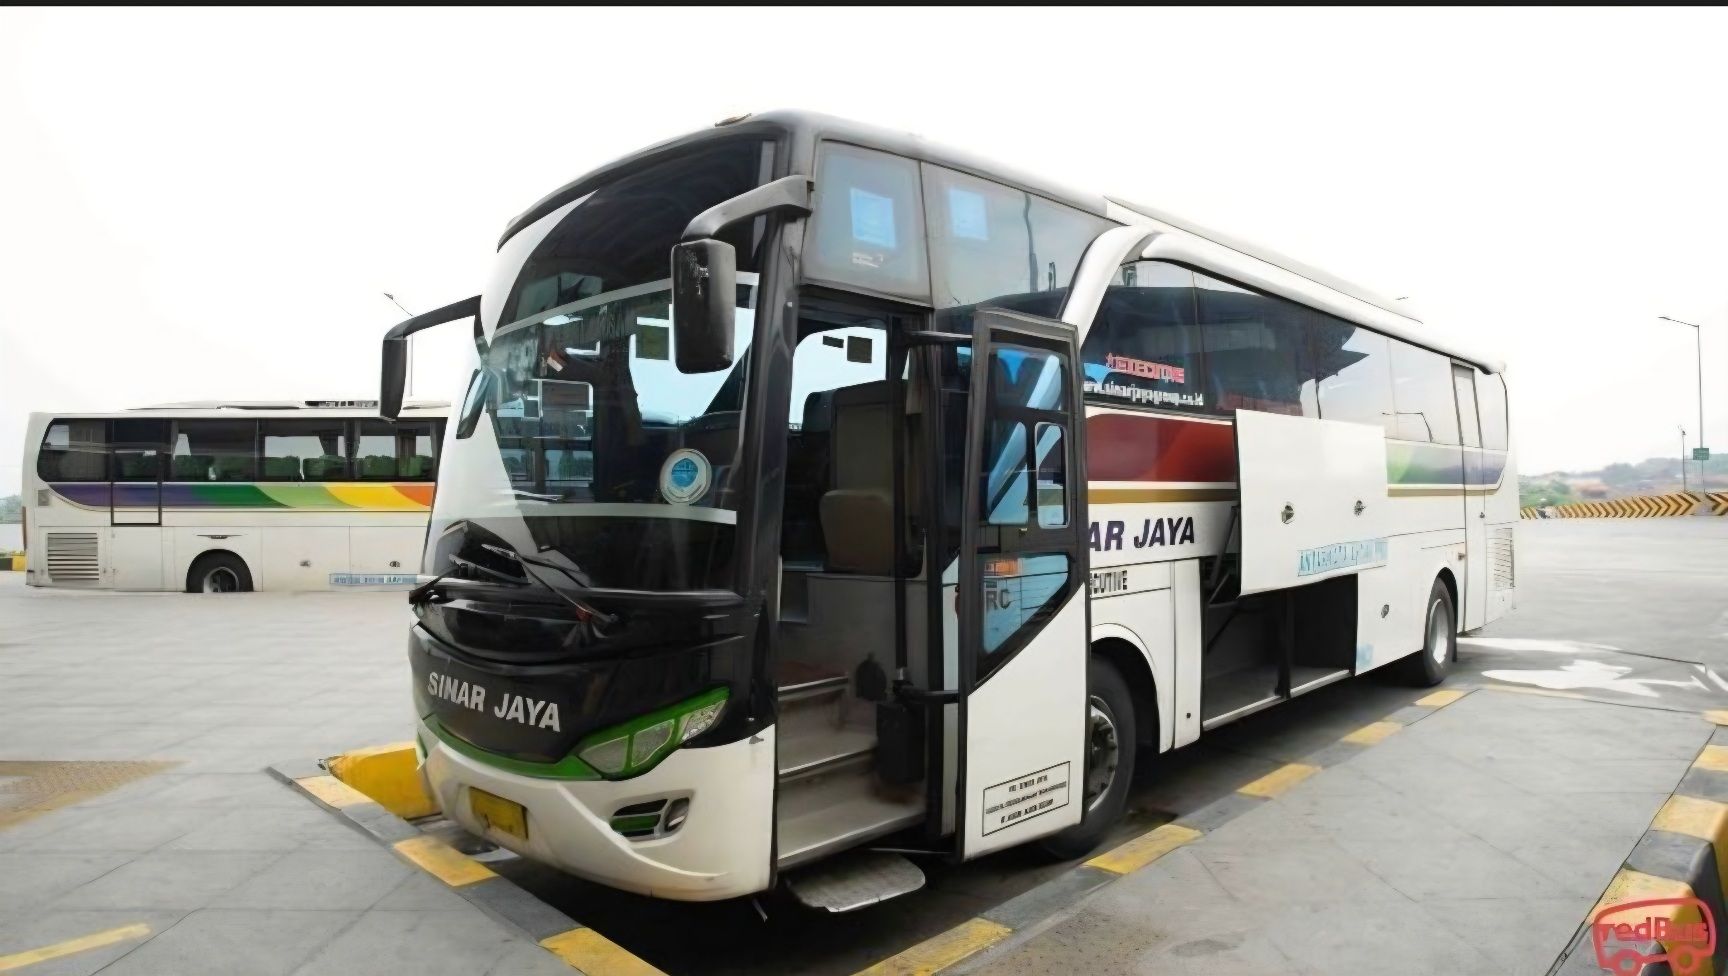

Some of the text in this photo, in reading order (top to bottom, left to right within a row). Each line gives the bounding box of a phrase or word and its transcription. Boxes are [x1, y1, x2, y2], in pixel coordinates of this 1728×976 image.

[1133, 516, 1195, 549] JAYA
[427, 671, 561, 733] SINAR JAYA
